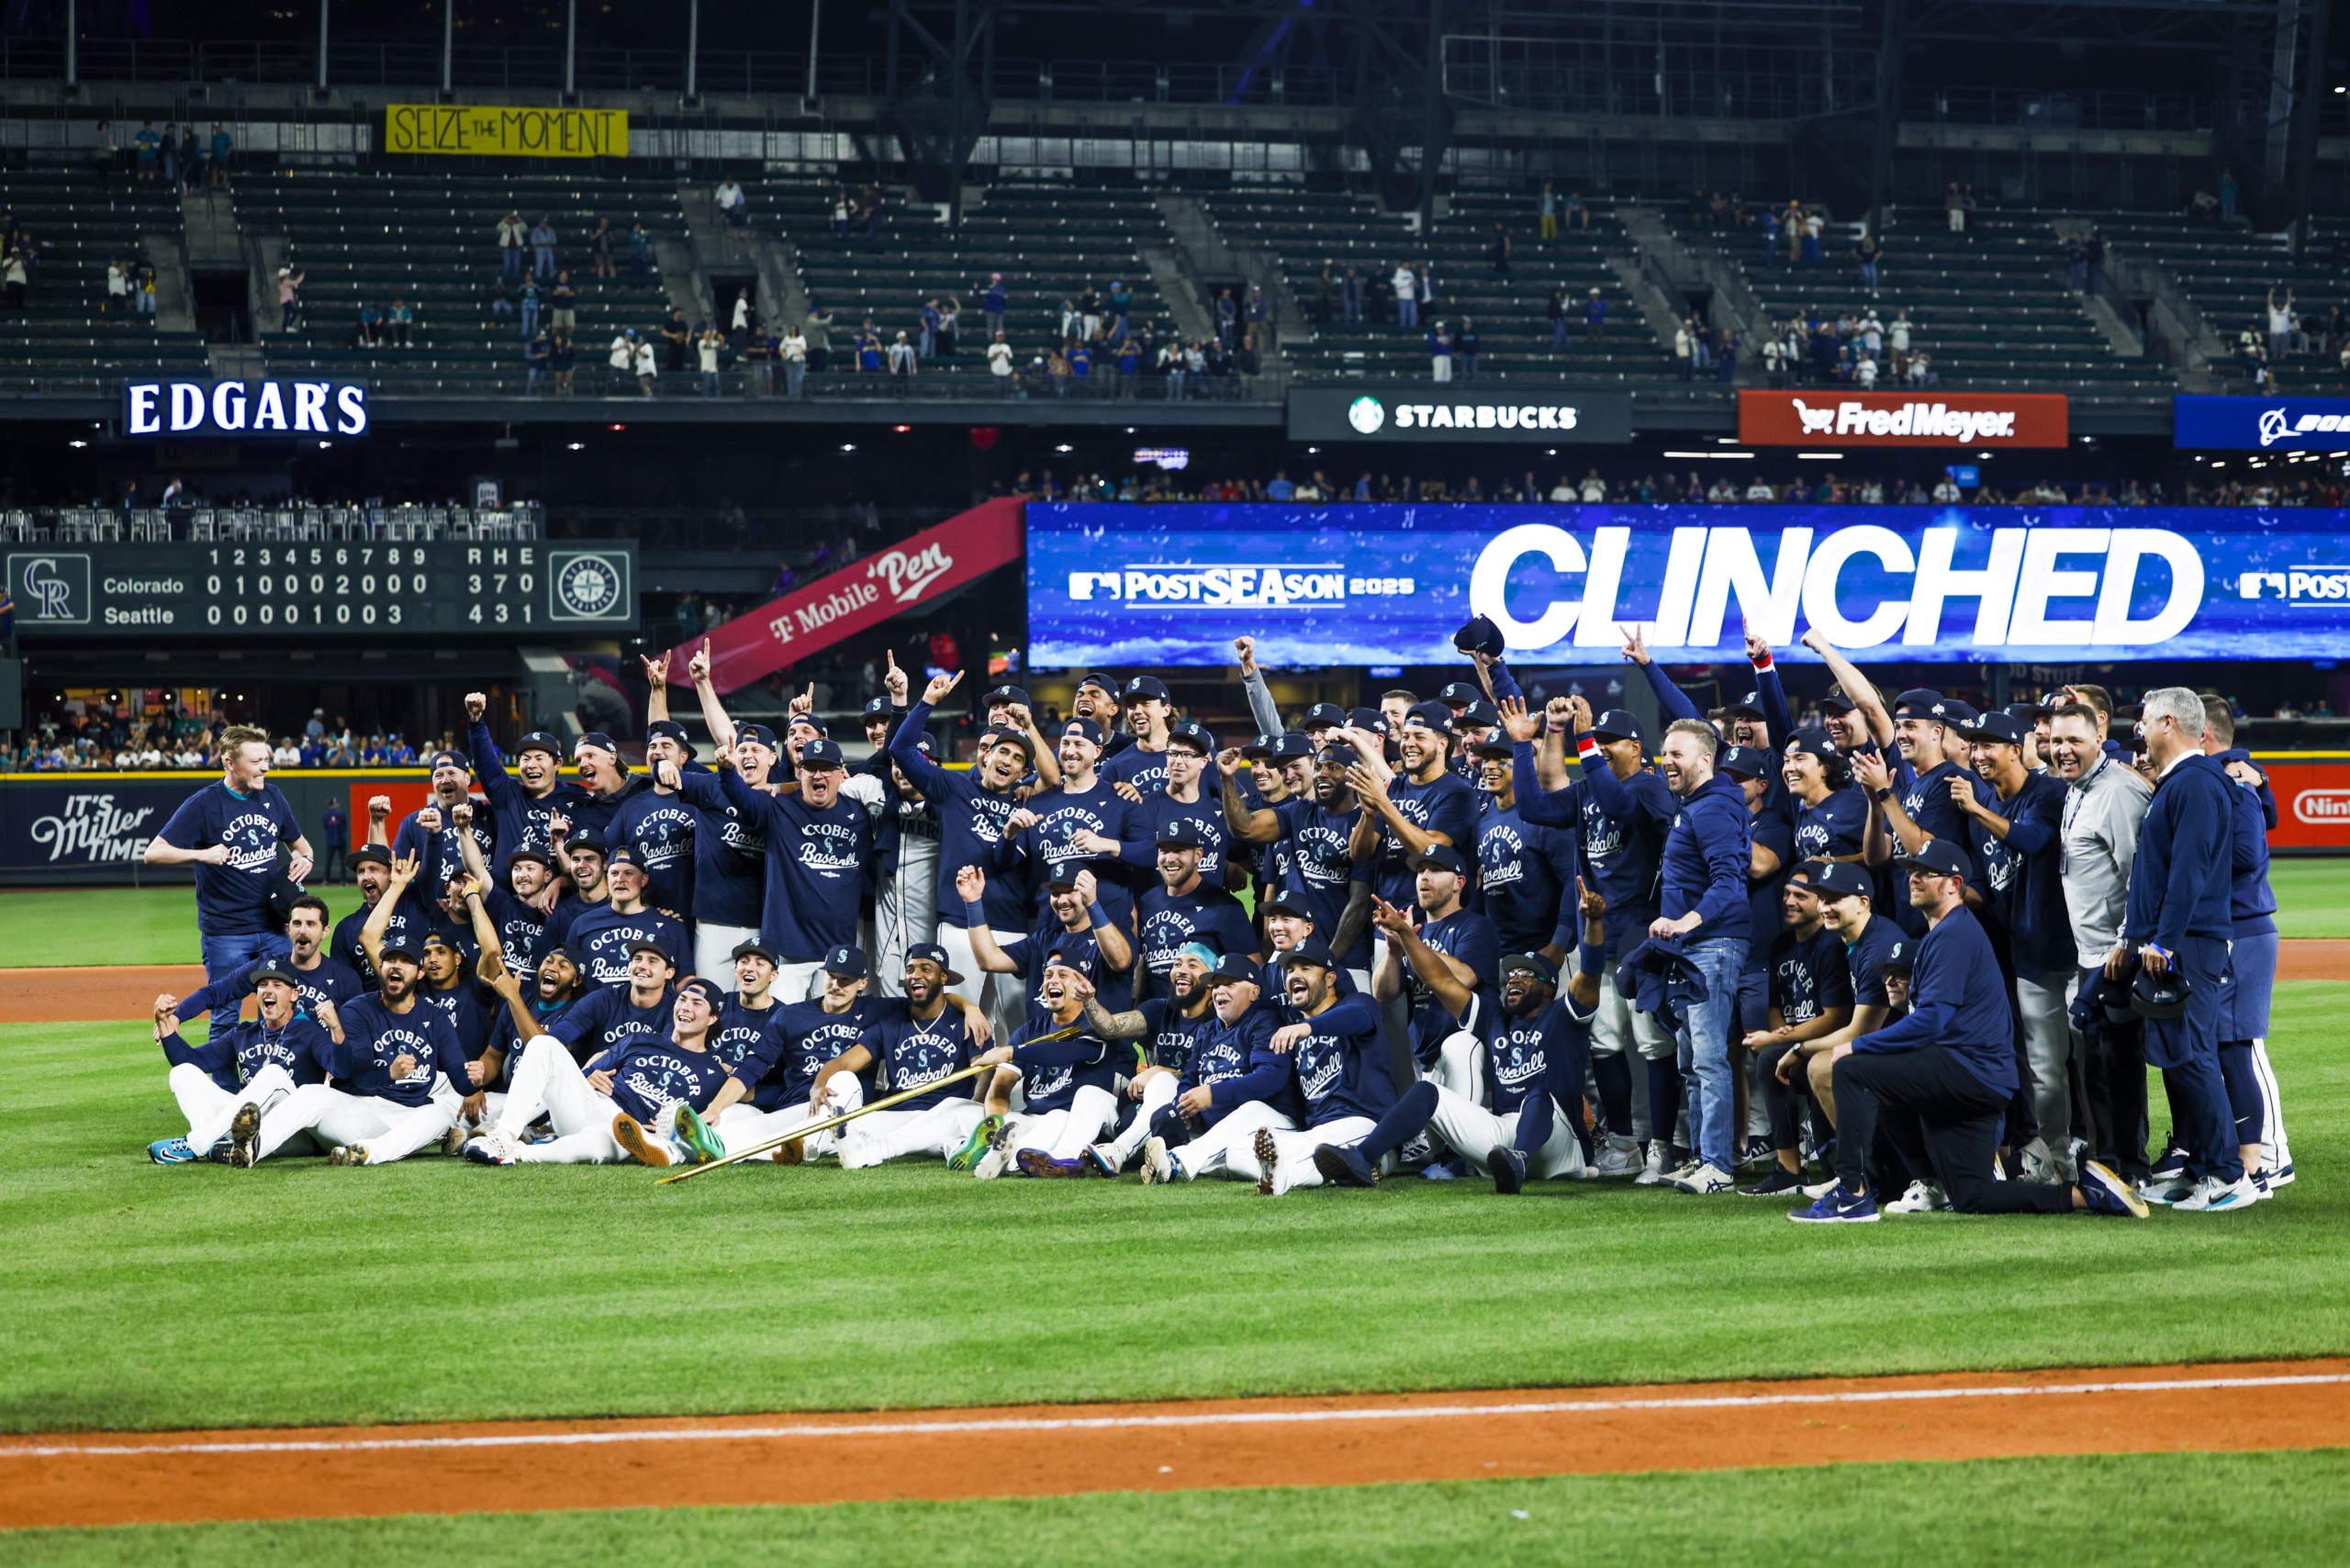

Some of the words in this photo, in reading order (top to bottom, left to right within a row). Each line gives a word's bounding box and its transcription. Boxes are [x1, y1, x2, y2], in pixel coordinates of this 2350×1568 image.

[396, 107, 471, 150] SEIZE
[472, 120, 498, 137] THE
[501, 110, 616, 152] MOMENT
[129, 381, 366, 434] EDGAR'S
[1394, 404, 1578, 429] STARBUCKS
[210, 549, 218, 566] 1
[234, 549, 245, 566] 2
[260, 549, 271, 566] 3
[285, 549, 297, 565] 4
[310, 548, 321, 565] 5
[336, 548, 348, 565] 6
[362, 548, 373, 565] 7
[388, 548, 400, 565] 8
[413, 548, 425, 566] 9
[468, 548, 482, 565] R
[493, 548, 508, 566] H
[520, 547, 533, 565] E
[104, 577, 184, 594] Colorado
[207, 575, 221, 595] 0
[236, 576, 244, 595] 1
[259, 575, 273, 595] 0
[285, 575, 298, 594] 0
[310, 574, 324, 594] 0
[336, 575, 349, 594] 2
[362, 575, 375, 594] 0
[387, 574, 401, 594] 0
[413, 574, 427, 593] 0
[469, 574, 482, 594] 3
[494, 574, 508, 593] 7
[520, 573, 533, 593] 0
[1348, 577, 1415, 595] 2025
[1469, 523, 2205, 649] CLINCHED
[105, 607, 174, 625] Seattle
[207, 605, 221, 625] 0
[233, 605, 247, 625] 0
[260, 604, 274, 624] 0
[285, 605, 298, 624] 0
[314, 605, 321, 624] 1
[336, 604, 351, 623] 0
[362, 604, 376, 624] 0
[388, 605, 401, 624] 3
[468, 604, 483, 623] 4
[495, 603, 509, 623] 3
[523, 604, 532, 623] 1
[795, 581, 880, 633] Mobile
[64, 794, 115, 818] IT'S
[31, 806, 154, 862] Miller
[222, 813, 278, 843] OCTOBER
[1039, 807, 1104, 834] OCTOBER
[89, 837, 150, 861] TIME
[1478, 825, 1523, 857] OCTOBER
[1140, 910, 1195, 937] OCTOBER
[238, 1044, 296, 1064] OCTOBER
[374, 1029, 432, 1058] OCTOBER
[894, 1036, 957, 1060] OCTOBER
[635, 1056, 701, 1096] OCTOBER
[896, 1062, 955, 1090] Baseball
